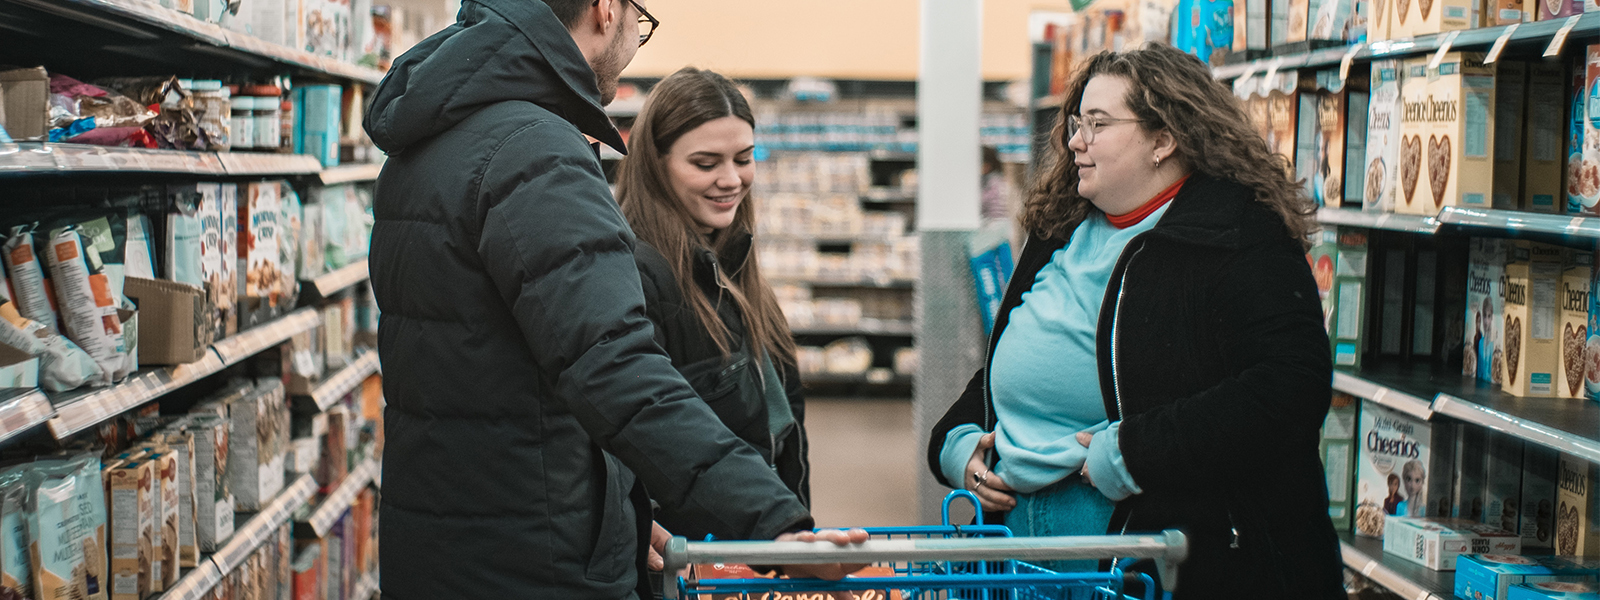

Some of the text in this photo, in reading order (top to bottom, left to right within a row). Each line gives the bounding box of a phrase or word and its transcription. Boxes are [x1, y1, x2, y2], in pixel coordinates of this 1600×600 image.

[1426, 92, 1457, 123] Cheerios
[1469, 270, 1492, 296] Cheerios
[1367, 429, 1420, 459] Cheerios
[1471, 545, 1490, 554] CORN
